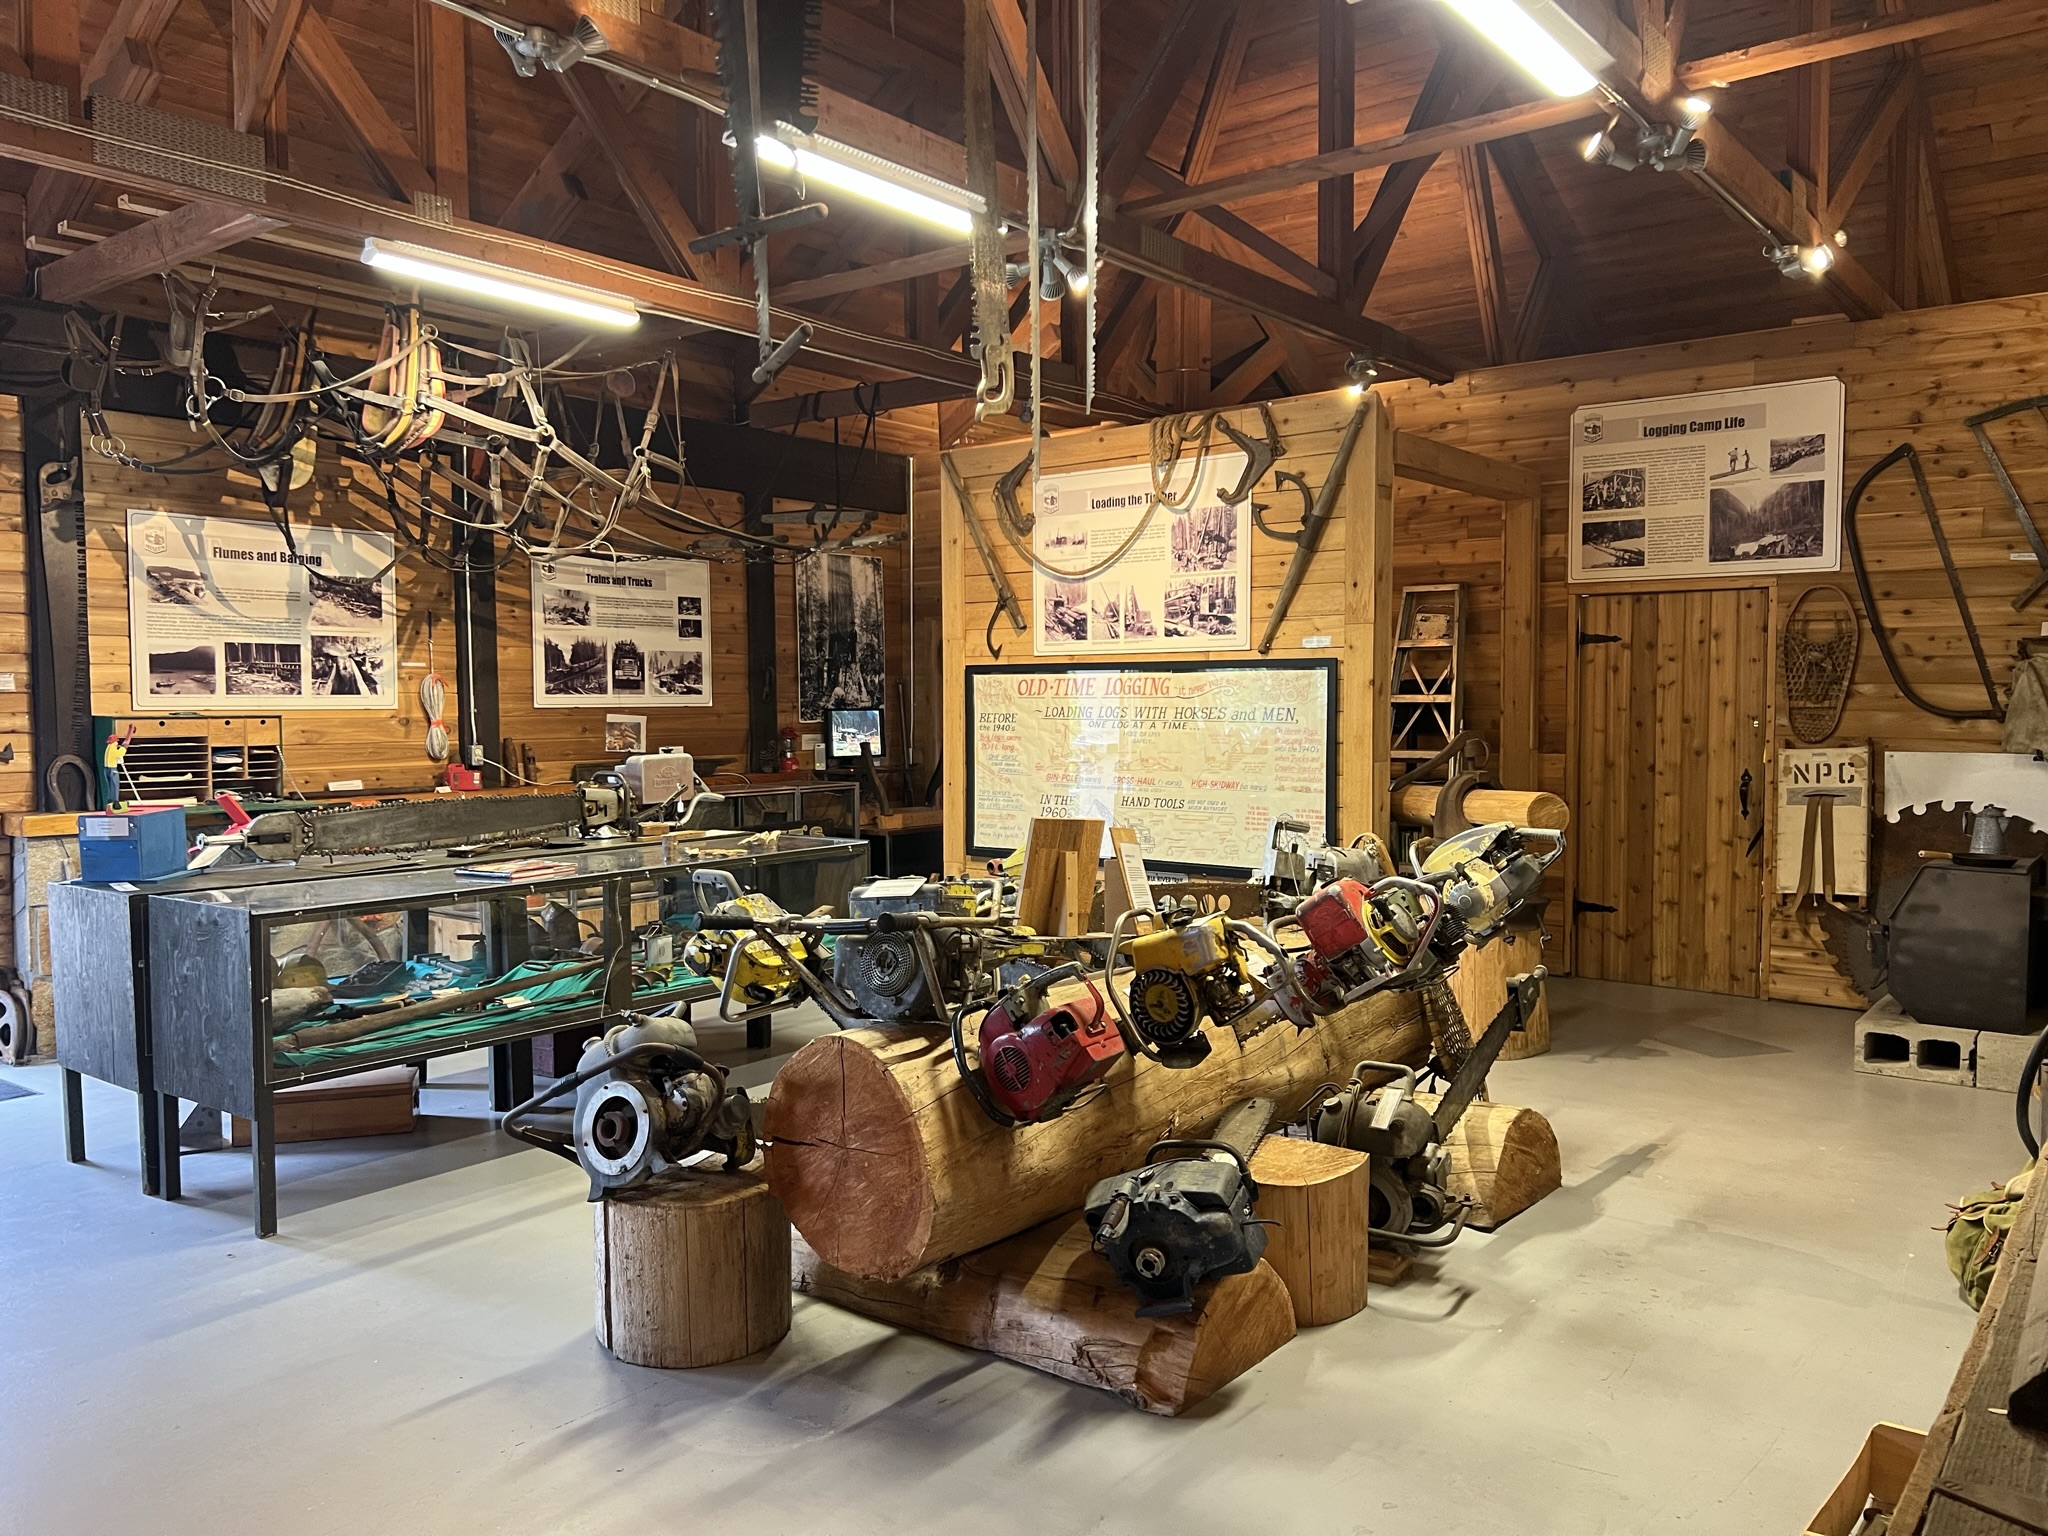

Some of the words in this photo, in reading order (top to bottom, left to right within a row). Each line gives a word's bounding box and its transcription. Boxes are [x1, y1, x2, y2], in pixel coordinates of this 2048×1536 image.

[1643, 419, 1687, 438] Logging
[1689, 417, 1722, 433] Camp
[1724, 416, 1745, 429] Life
[1091, 495, 1126, 510] Loading
[1128, 494, 1143, 507] the
[1145, 490, 1177, 505] Tier
[213, 547, 253, 561] Flumes
[256, 550, 277, 563] and
[280, 552, 322, 567] Barging
[586, 573, 611, 585] Trains
[612, 576, 626, 586] and
[628, 577, 653, 588] Trucks
[1104, 676, 1171, 697] LOGGING
[979, 713, 1018, 724] BEFORE
[1098, 706, 1129, 718] LOGS
[1134, 706, 1168, 720] WITH
[1174, 706, 1227, 720] HORSES
[1230, 707, 1257, 721] and
[1261, 707, 1299, 724] MEN,
[979, 724, 991, 732] the
[992, 724, 1016, 732] 1940's
[1112, 721, 1130, 729] LOG
[1132, 721, 1144, 729] AT
[1149, 721, 1156, 730] A
[1040, 794, 1052, 804] IN
[1054, 795, 1076, 806] THE
